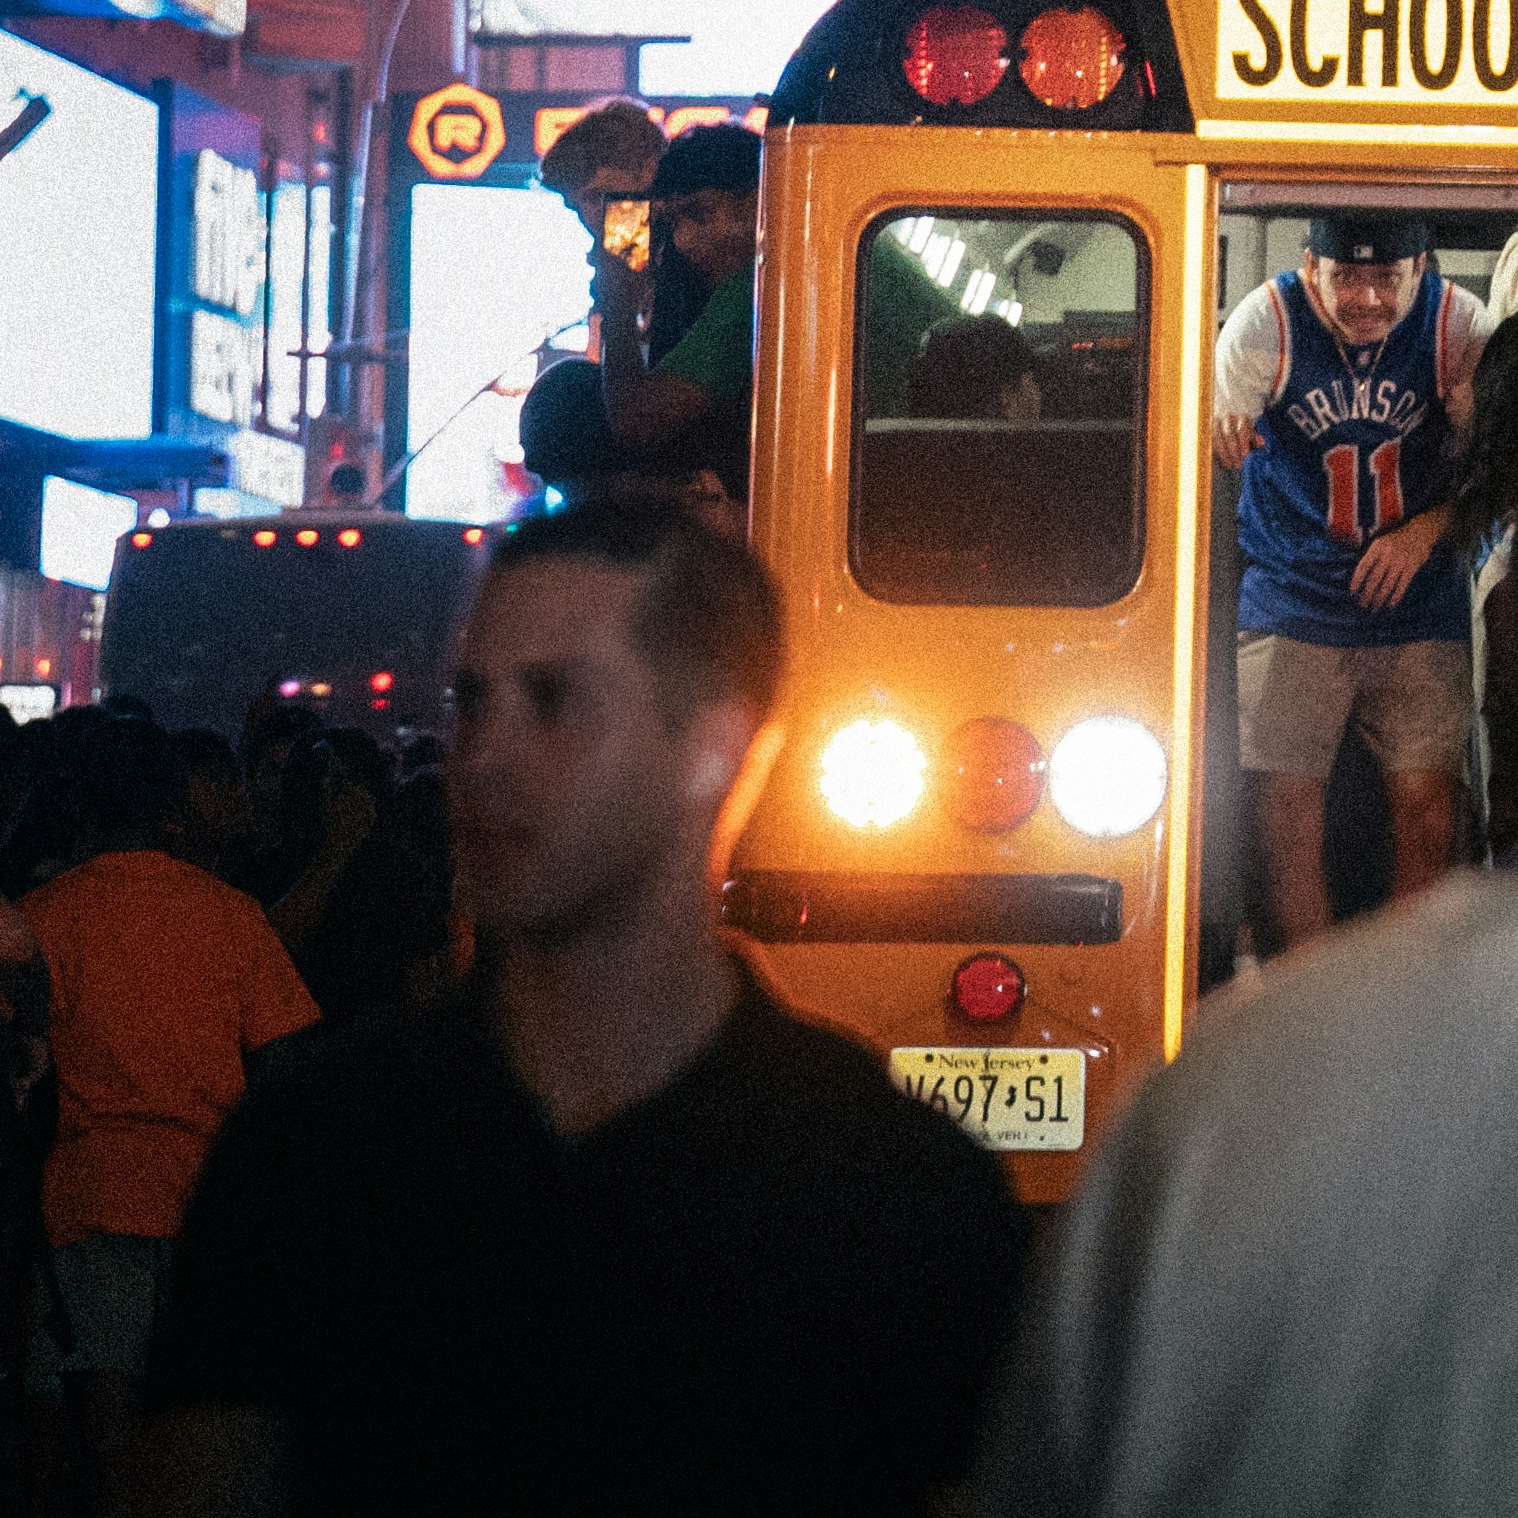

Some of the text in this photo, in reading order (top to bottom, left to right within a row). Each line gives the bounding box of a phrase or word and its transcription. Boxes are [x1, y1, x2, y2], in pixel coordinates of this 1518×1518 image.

[1288, 378, 1430, 442] BRUNSON
[1323, 436, 1405, 547] 11
[938, 1053, 977, 1070] New
